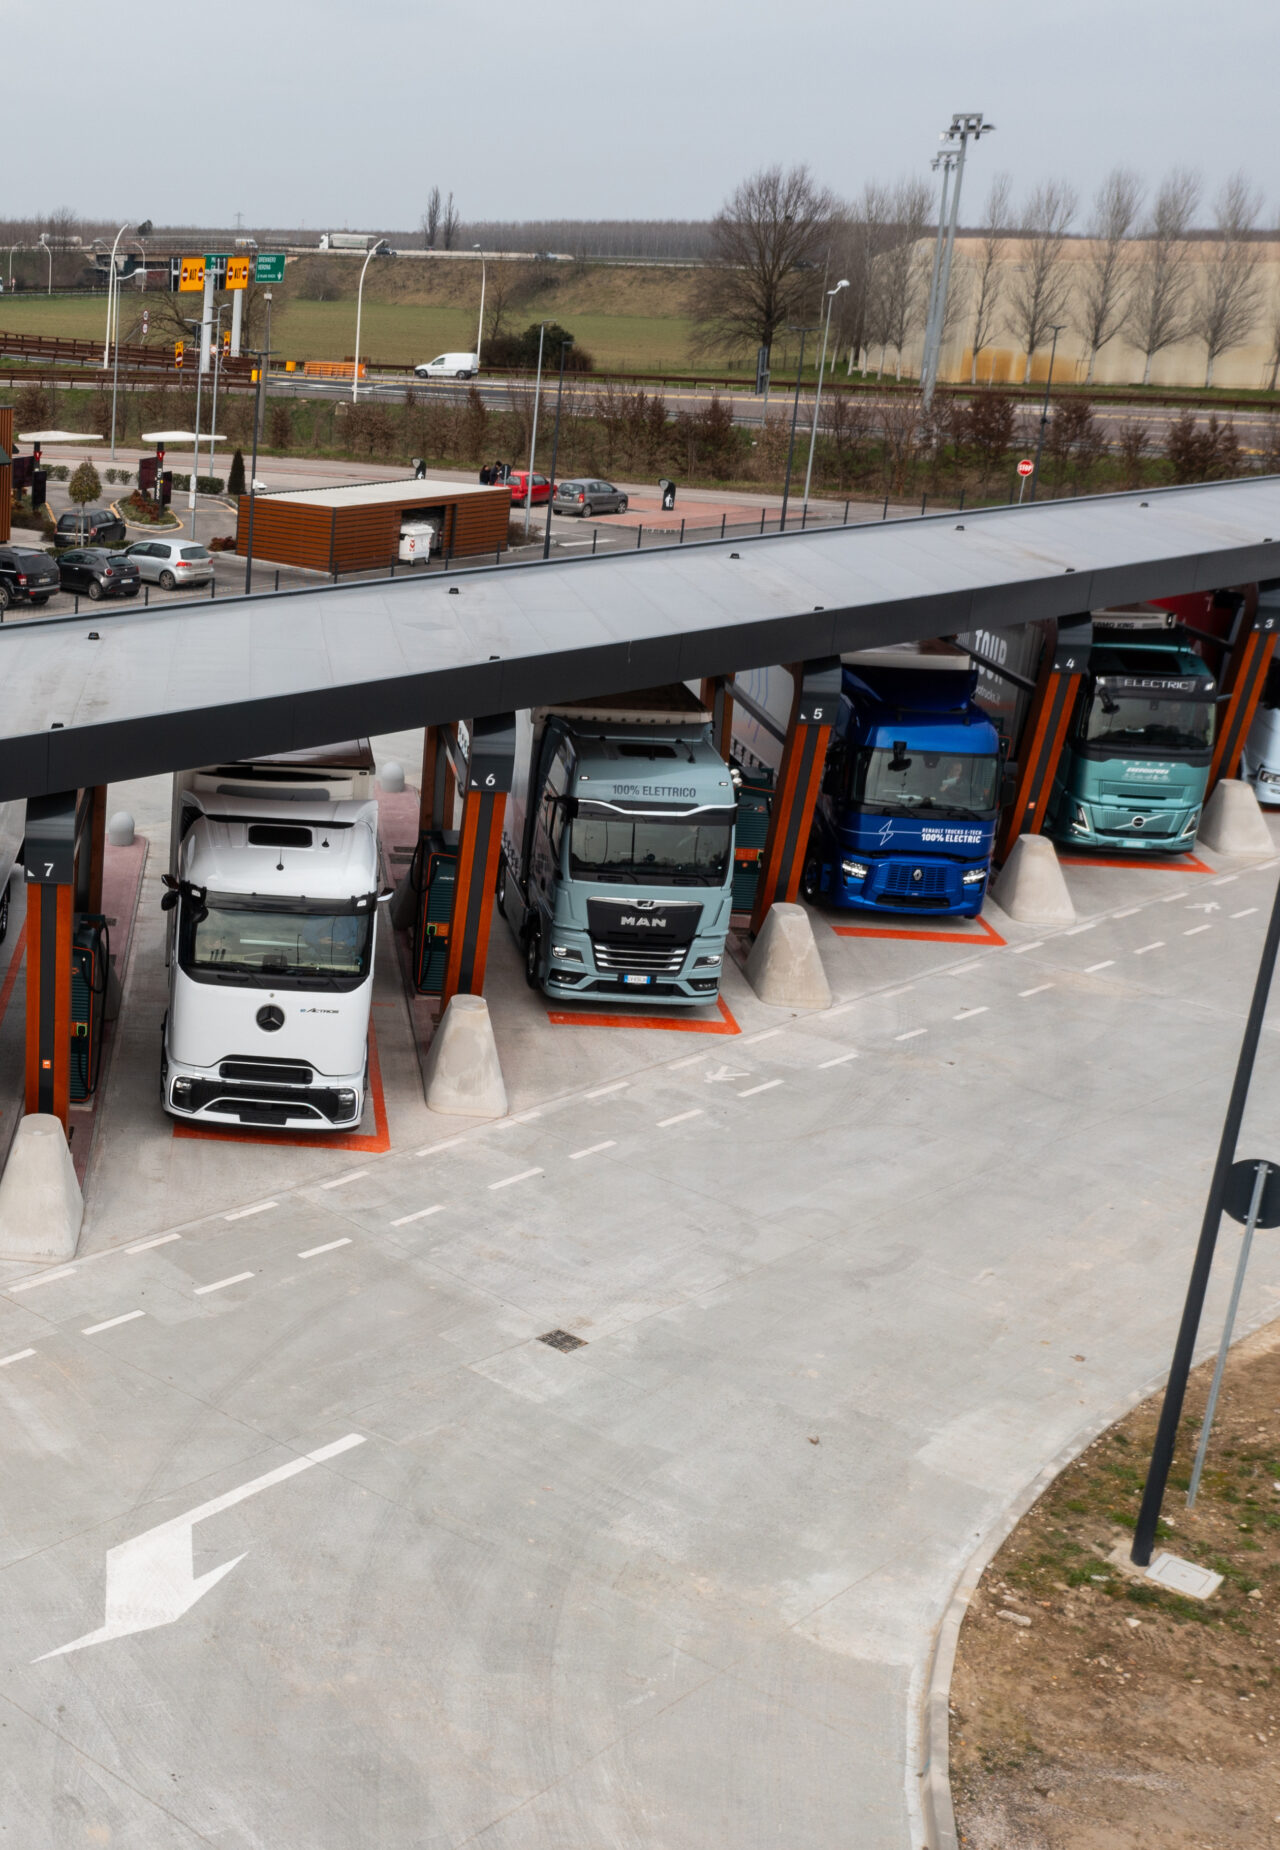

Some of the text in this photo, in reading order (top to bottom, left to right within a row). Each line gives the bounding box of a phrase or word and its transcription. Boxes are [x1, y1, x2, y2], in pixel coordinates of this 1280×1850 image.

[189, 268, 197, 280] ALT
[234, 267, 242, 279] ALT
[1264, 618, 1274, 629] 3
[1066, 658, 1075, 669] 4
[1124, 679, 1190, 690] ELECTRIC
[813, 708, 823, 720] 5
[485, 773, 496, 786] 6
[612, 784, 697, 798] 100% ELETTRICO
[921, 833, 981, 844] 100% ELECTRIC
[43, 863, 54, 877] 7
[621, 916, 667, 928] MAN
